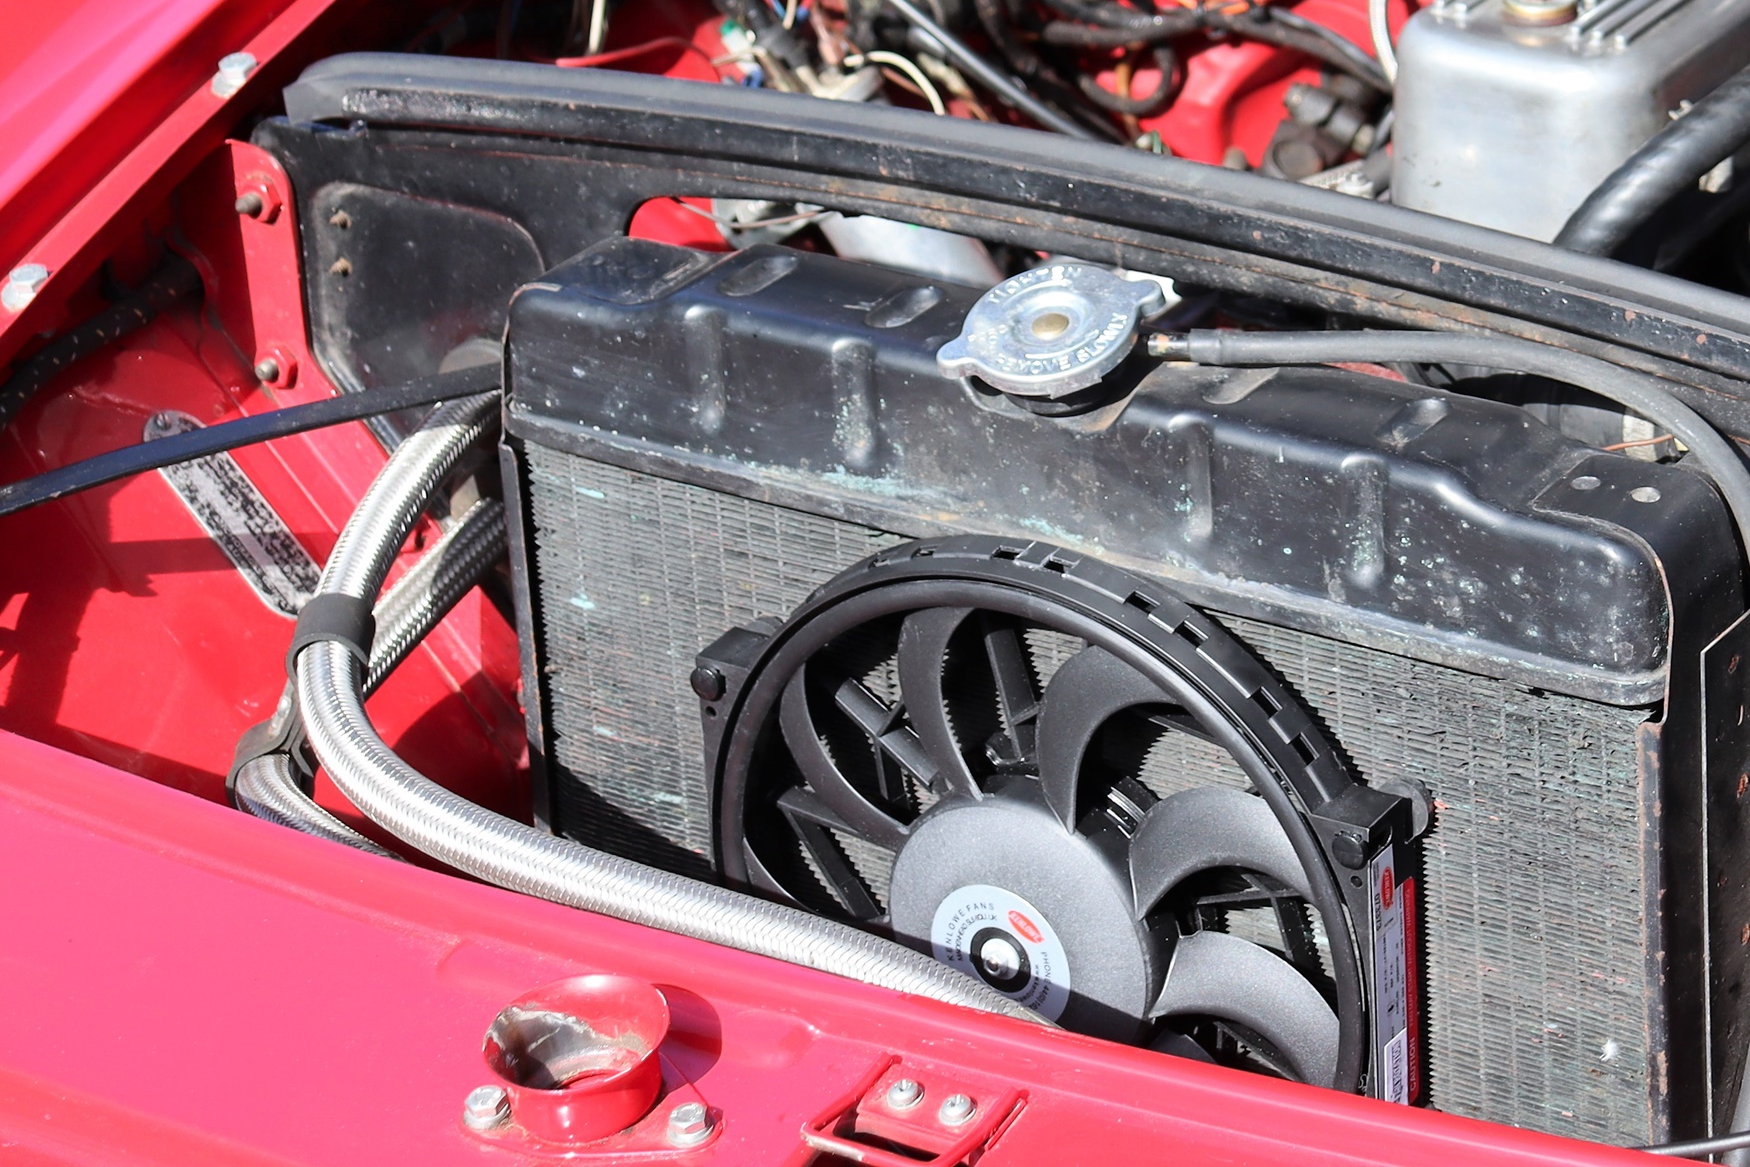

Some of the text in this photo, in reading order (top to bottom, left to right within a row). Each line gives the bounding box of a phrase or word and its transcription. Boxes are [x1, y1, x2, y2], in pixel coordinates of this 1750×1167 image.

[945, 901, 995, 961] KENLOWE FANS
[1040, 951, 1052, 985] PHONE
[1409, 1037, 1417, 1091] CAUTION
